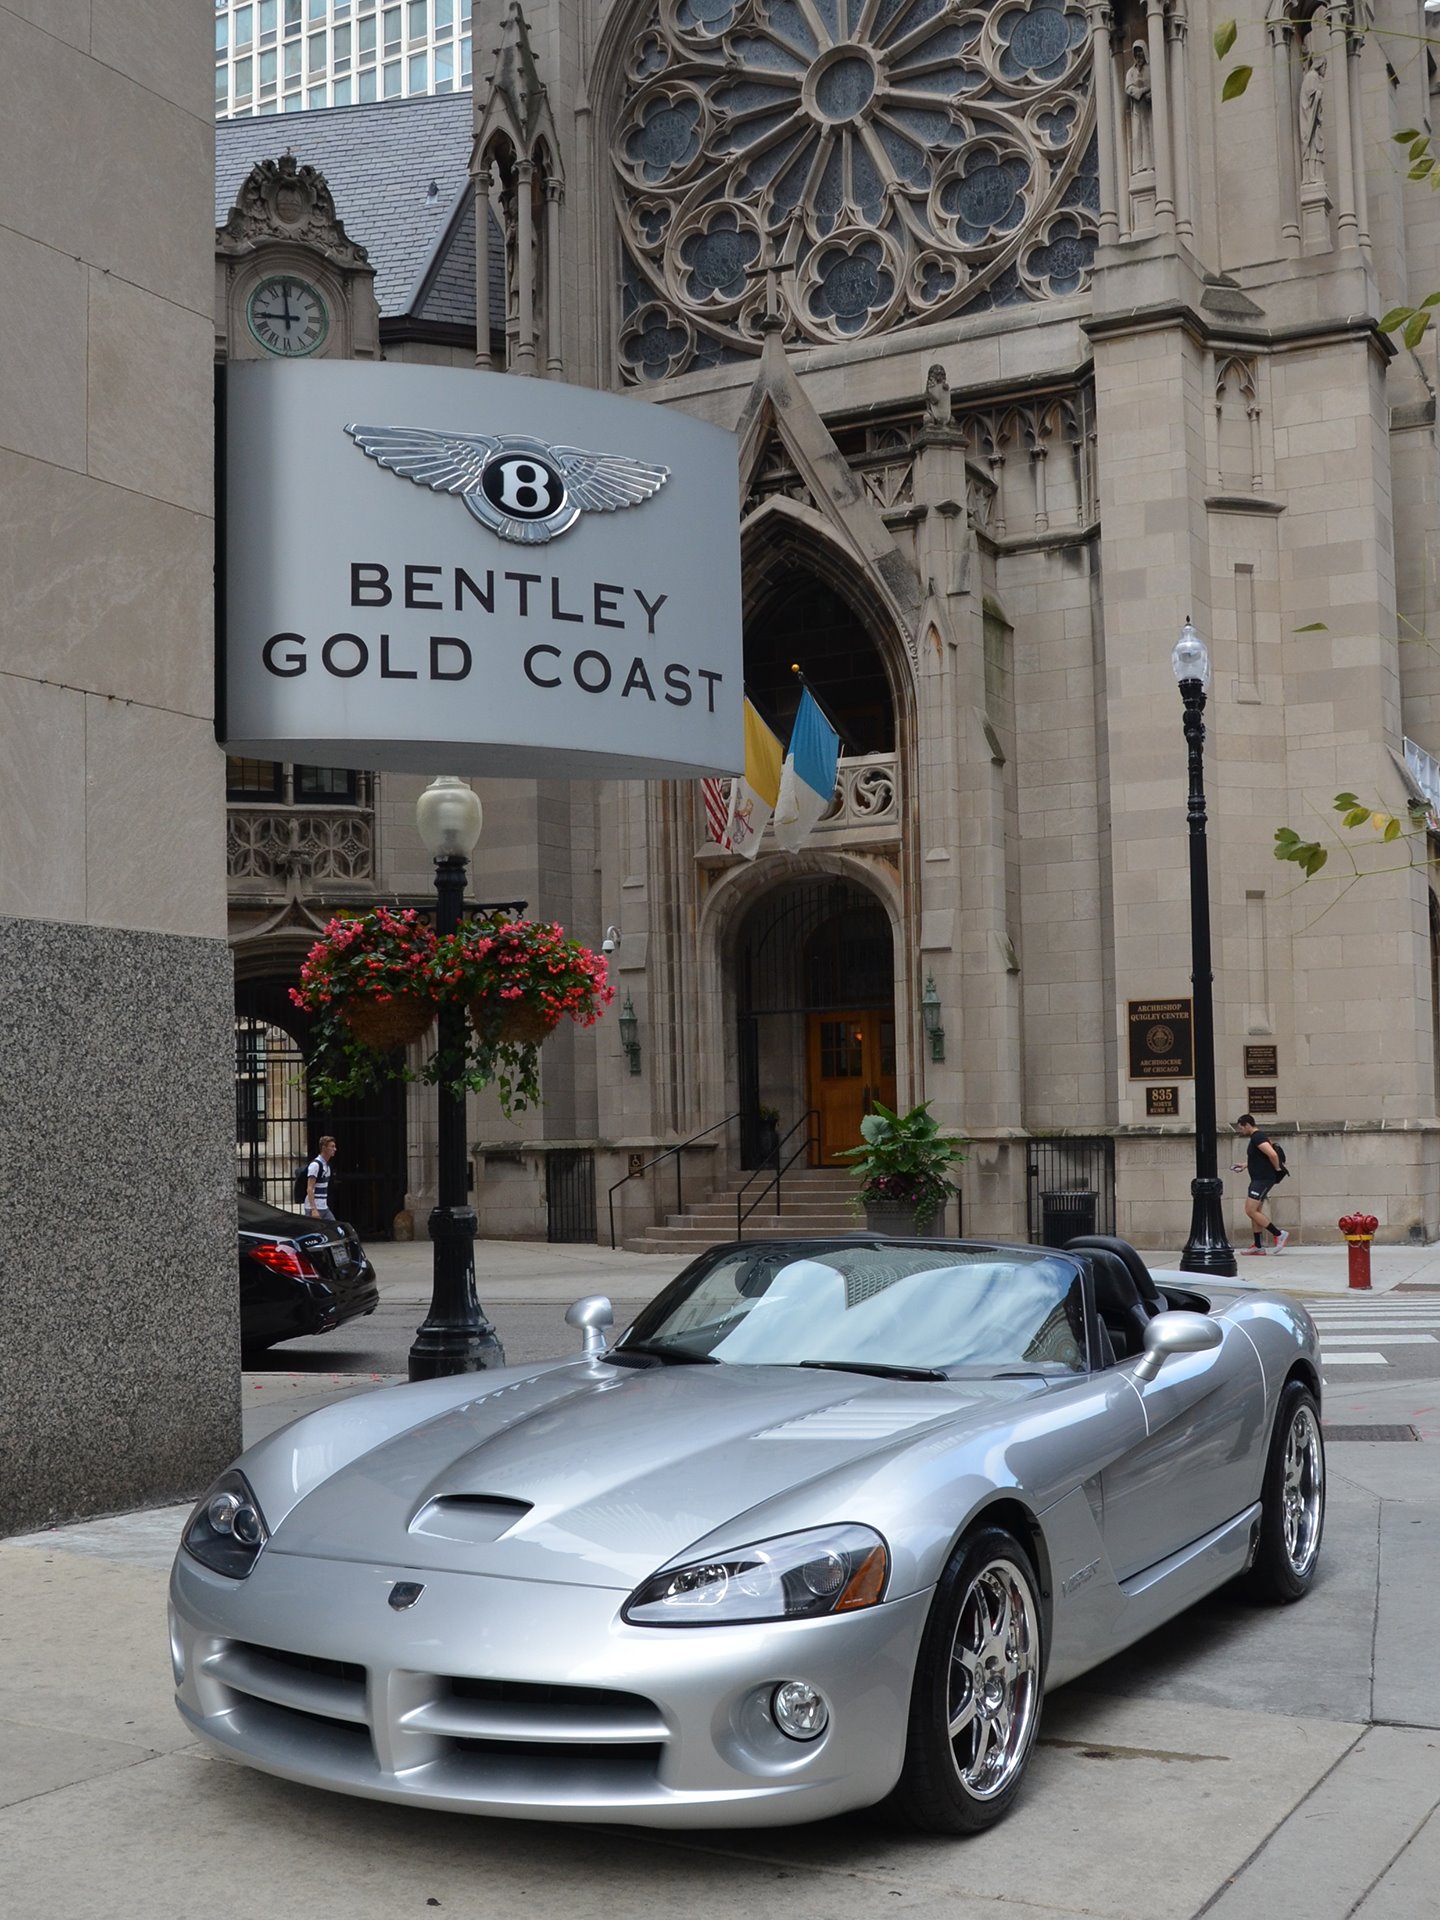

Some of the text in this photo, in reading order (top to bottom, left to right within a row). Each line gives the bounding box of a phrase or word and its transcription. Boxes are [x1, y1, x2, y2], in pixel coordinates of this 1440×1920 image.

[500, 460, 550, 512] B
[350, 562, 668, 634] BENTLEY
[261, 632, 723, 713] GOLD COAST
[1137, 1004, 1182, 1012] ARCHBISHOP
[1130, 1012, 1190, 1022] QUIGLEY CENTER
[1152, 1065, 1179, 1073] CHICAGO
[1152, 1089, 1173, 1101] 835
